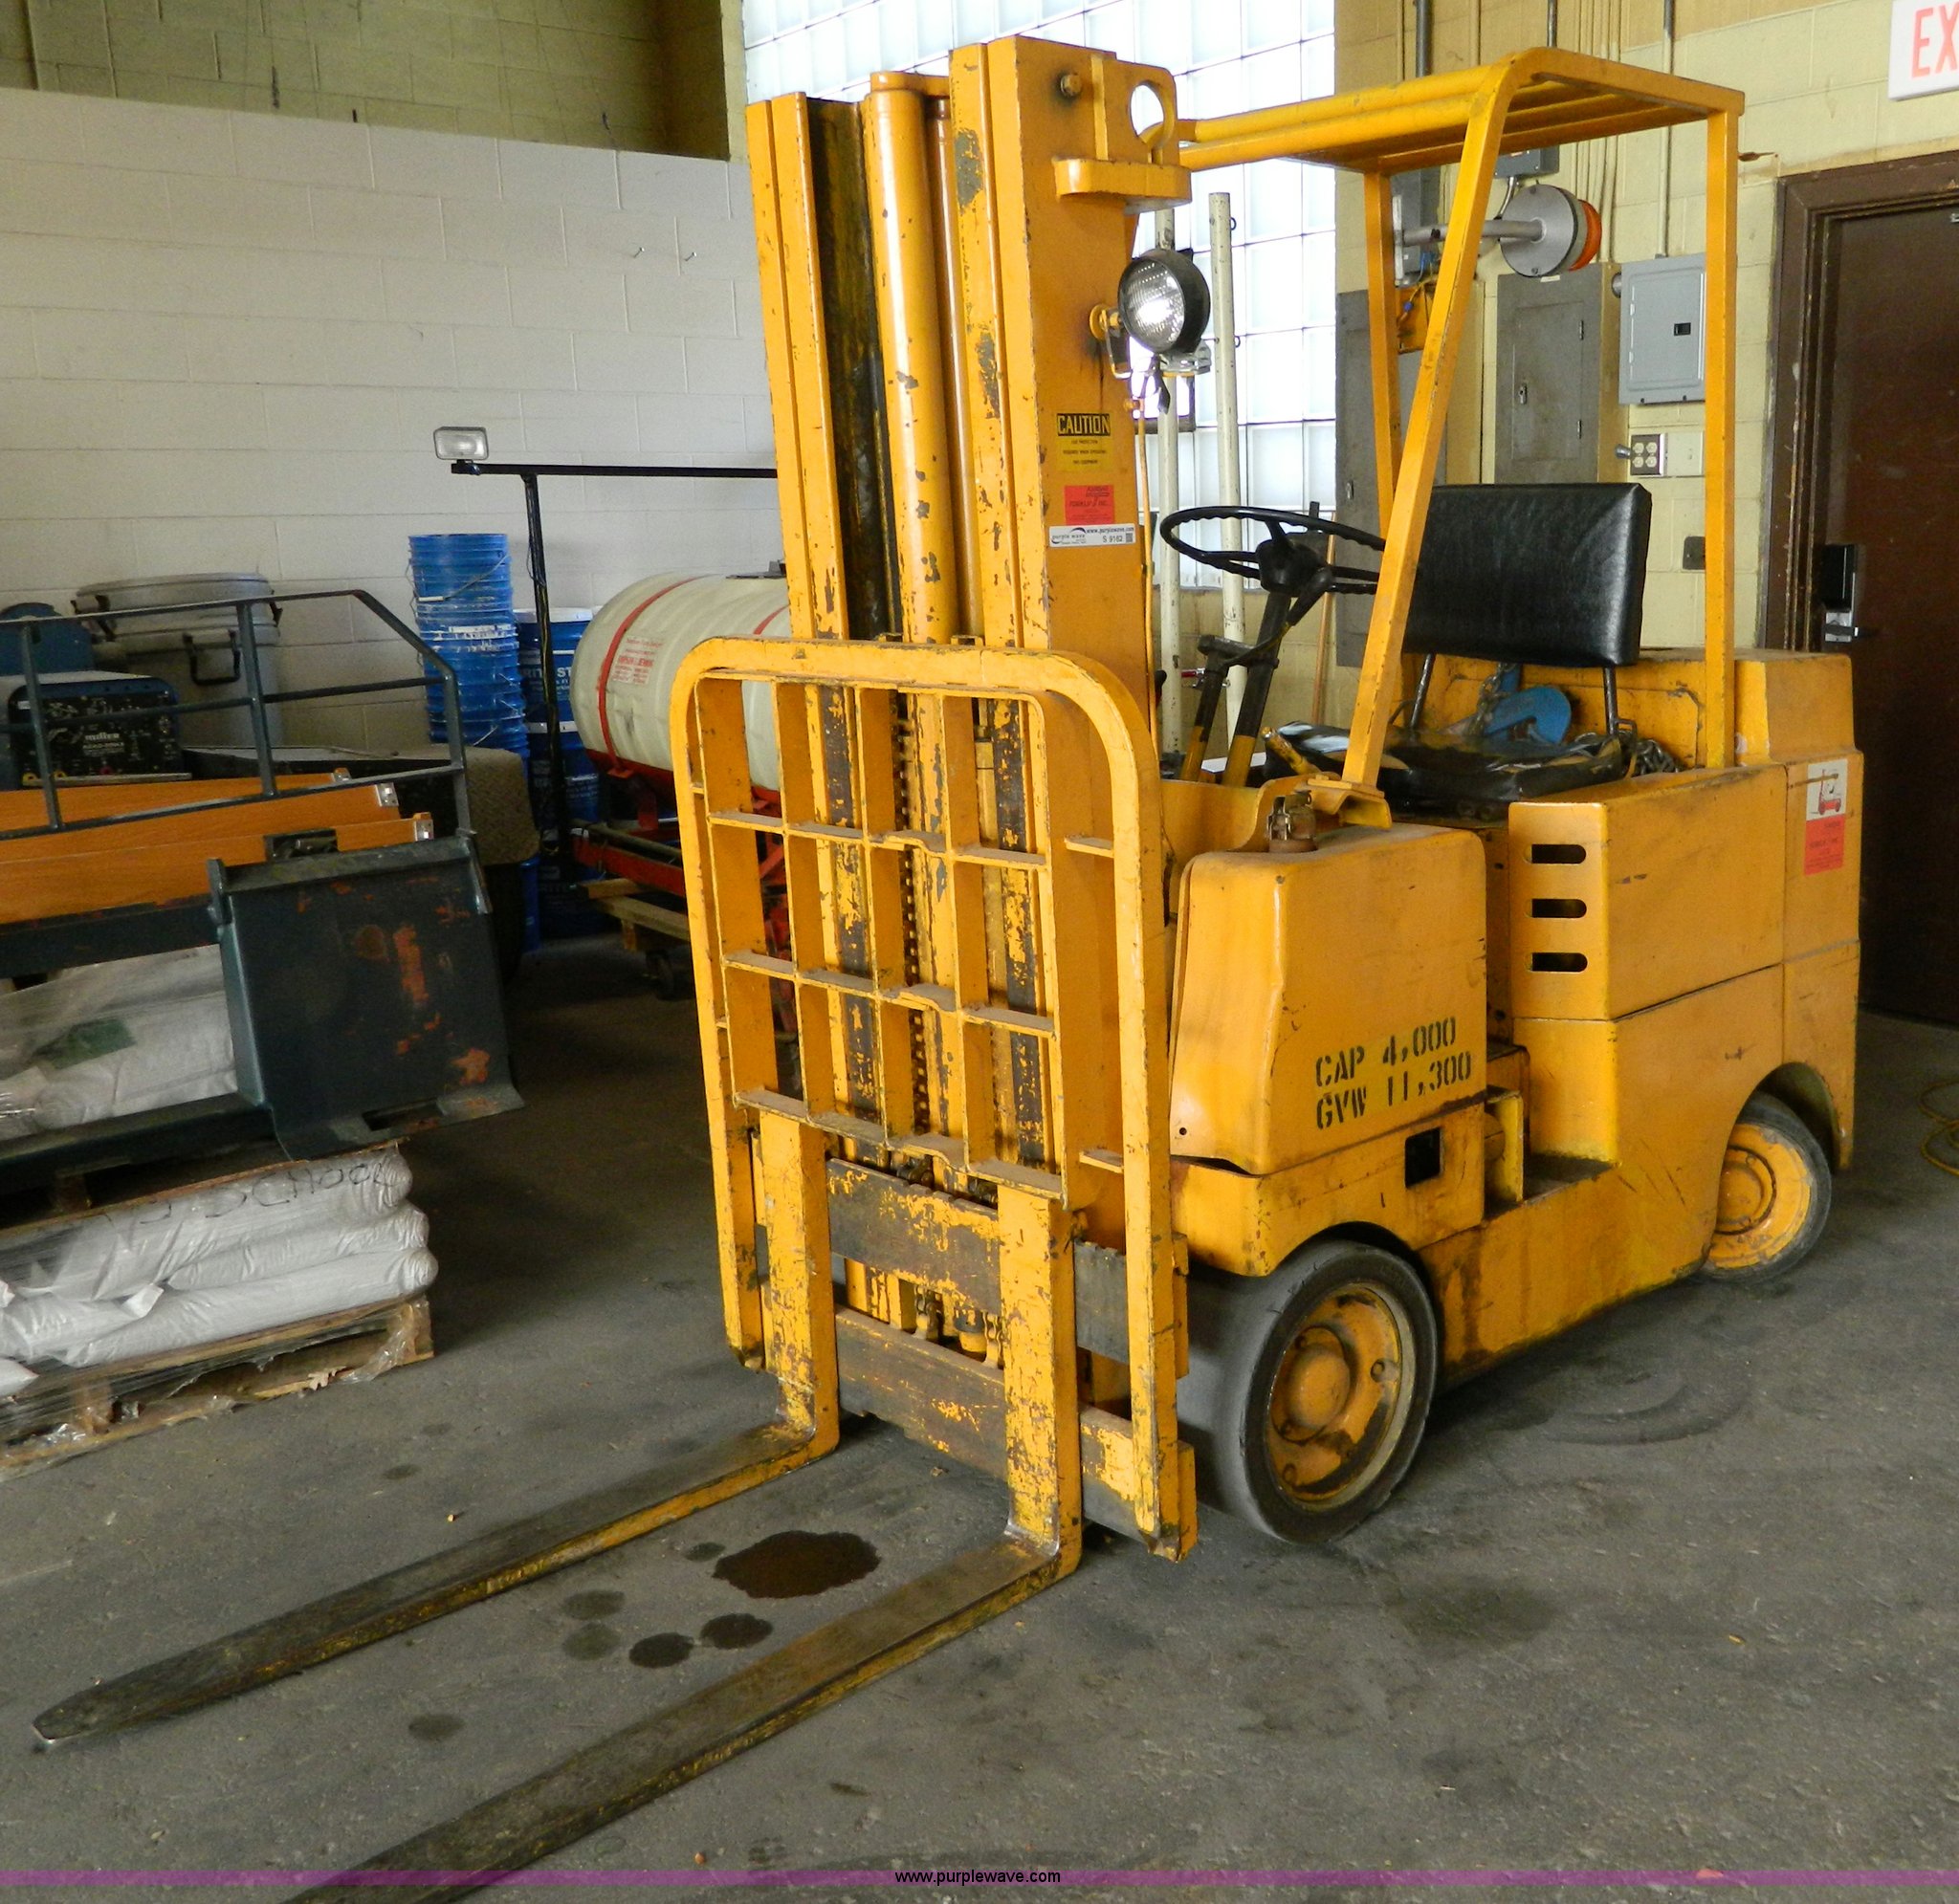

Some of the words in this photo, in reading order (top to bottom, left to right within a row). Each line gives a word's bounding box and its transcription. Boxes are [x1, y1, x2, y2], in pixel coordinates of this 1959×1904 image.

[1057, 415, 1110, 434] CAUTION
[1315, 1045, 1365, 1087] CAP
[1382, 1016, 1456, 1066] 4,000
[1316, 1086, 1367, 1129] GVW
[1388, 1051, 1472, 1107] 11,300
